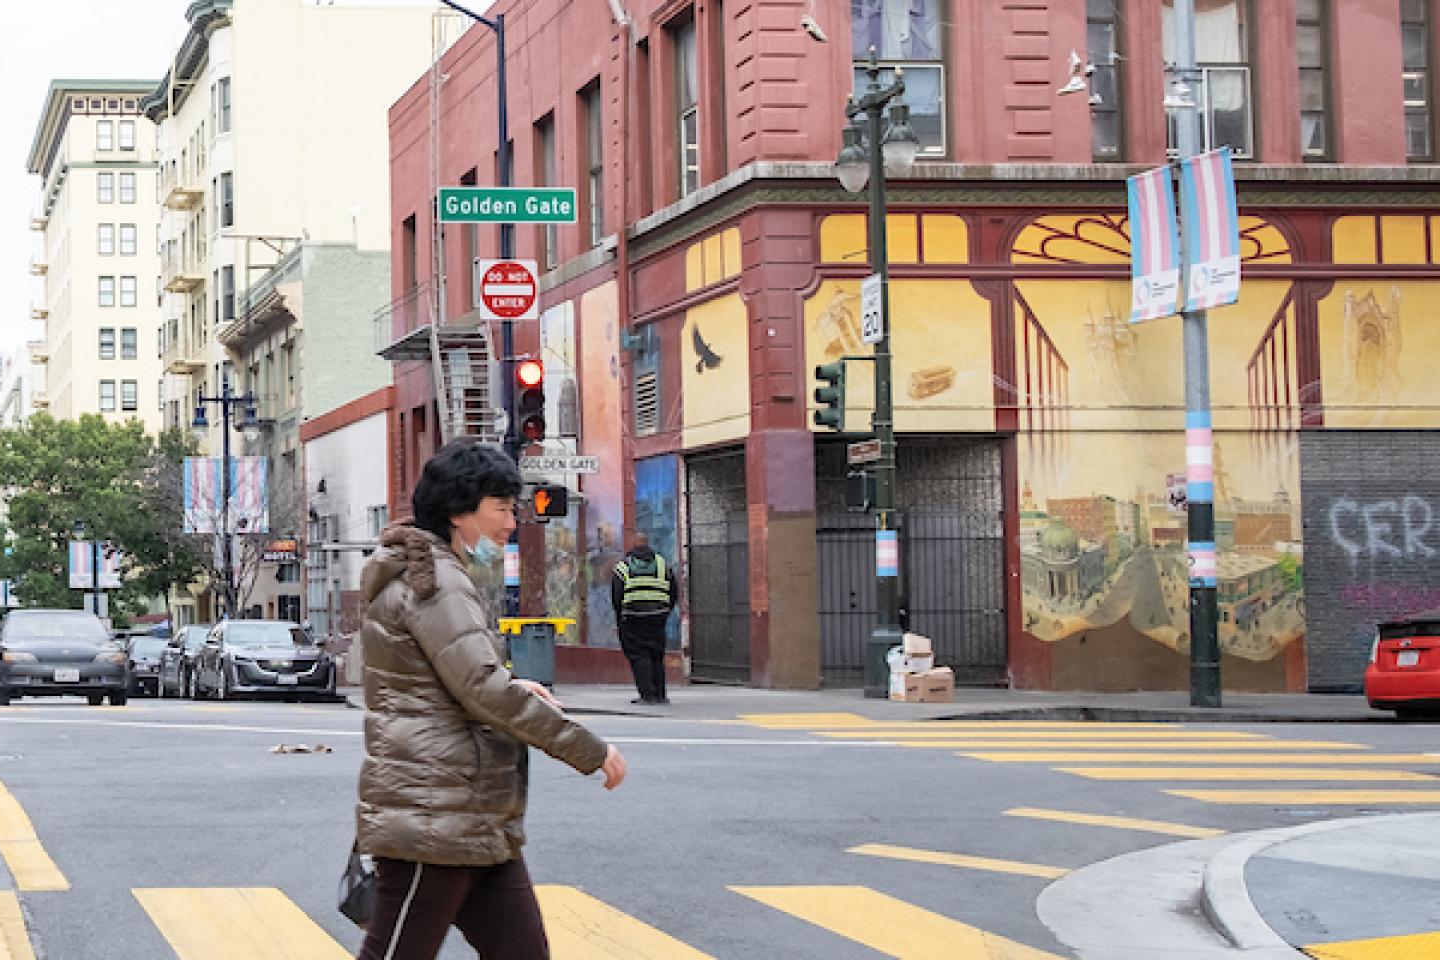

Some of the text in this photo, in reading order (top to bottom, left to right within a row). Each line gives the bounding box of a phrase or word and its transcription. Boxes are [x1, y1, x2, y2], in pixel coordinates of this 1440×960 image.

[446, 196, 571, 215] Golden Gate
[487, 272, 529, 282] DO NOT
[492, 297, 525, 308] ENTER
[864, 311, 879, 337] 20
[521, 457, 597, 471] GOLDEN GATE
